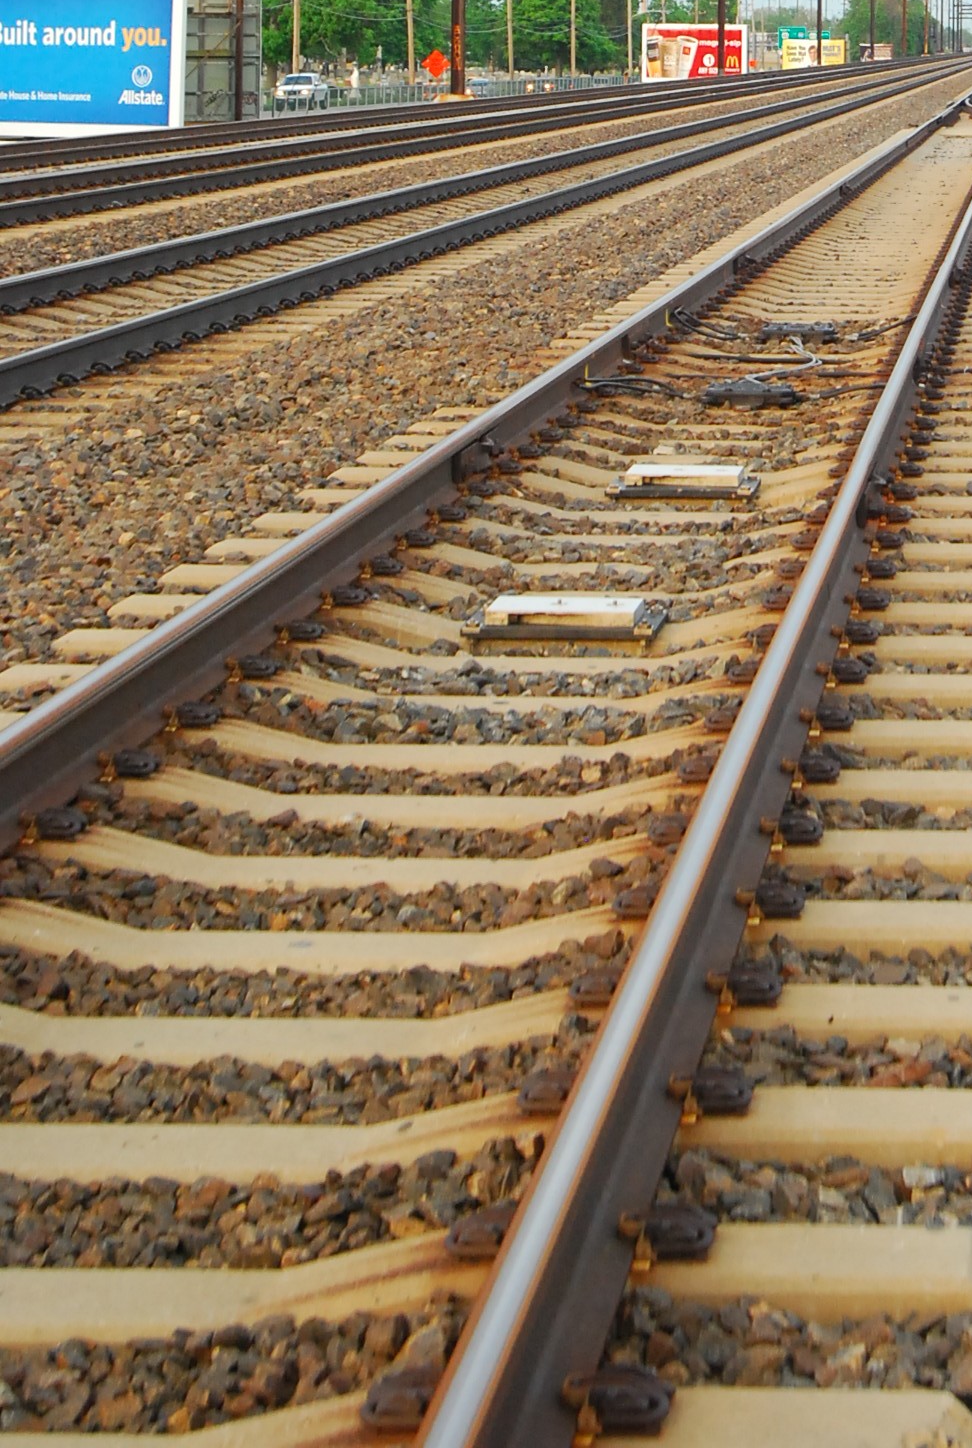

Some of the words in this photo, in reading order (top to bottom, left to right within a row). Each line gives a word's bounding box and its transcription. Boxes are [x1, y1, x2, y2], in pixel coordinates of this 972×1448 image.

[0, 20, 37, 46] uilt
[42, 20, 116, 46] around
[121, 27, 167, 52] you.
[8, 89, 30, 101] House
[30, 90, 37, 101] &
[37, 90, 58, 101] Home
[58, 91, 92, 102] Insurance
[118, 89, 164, 105] Allstate
